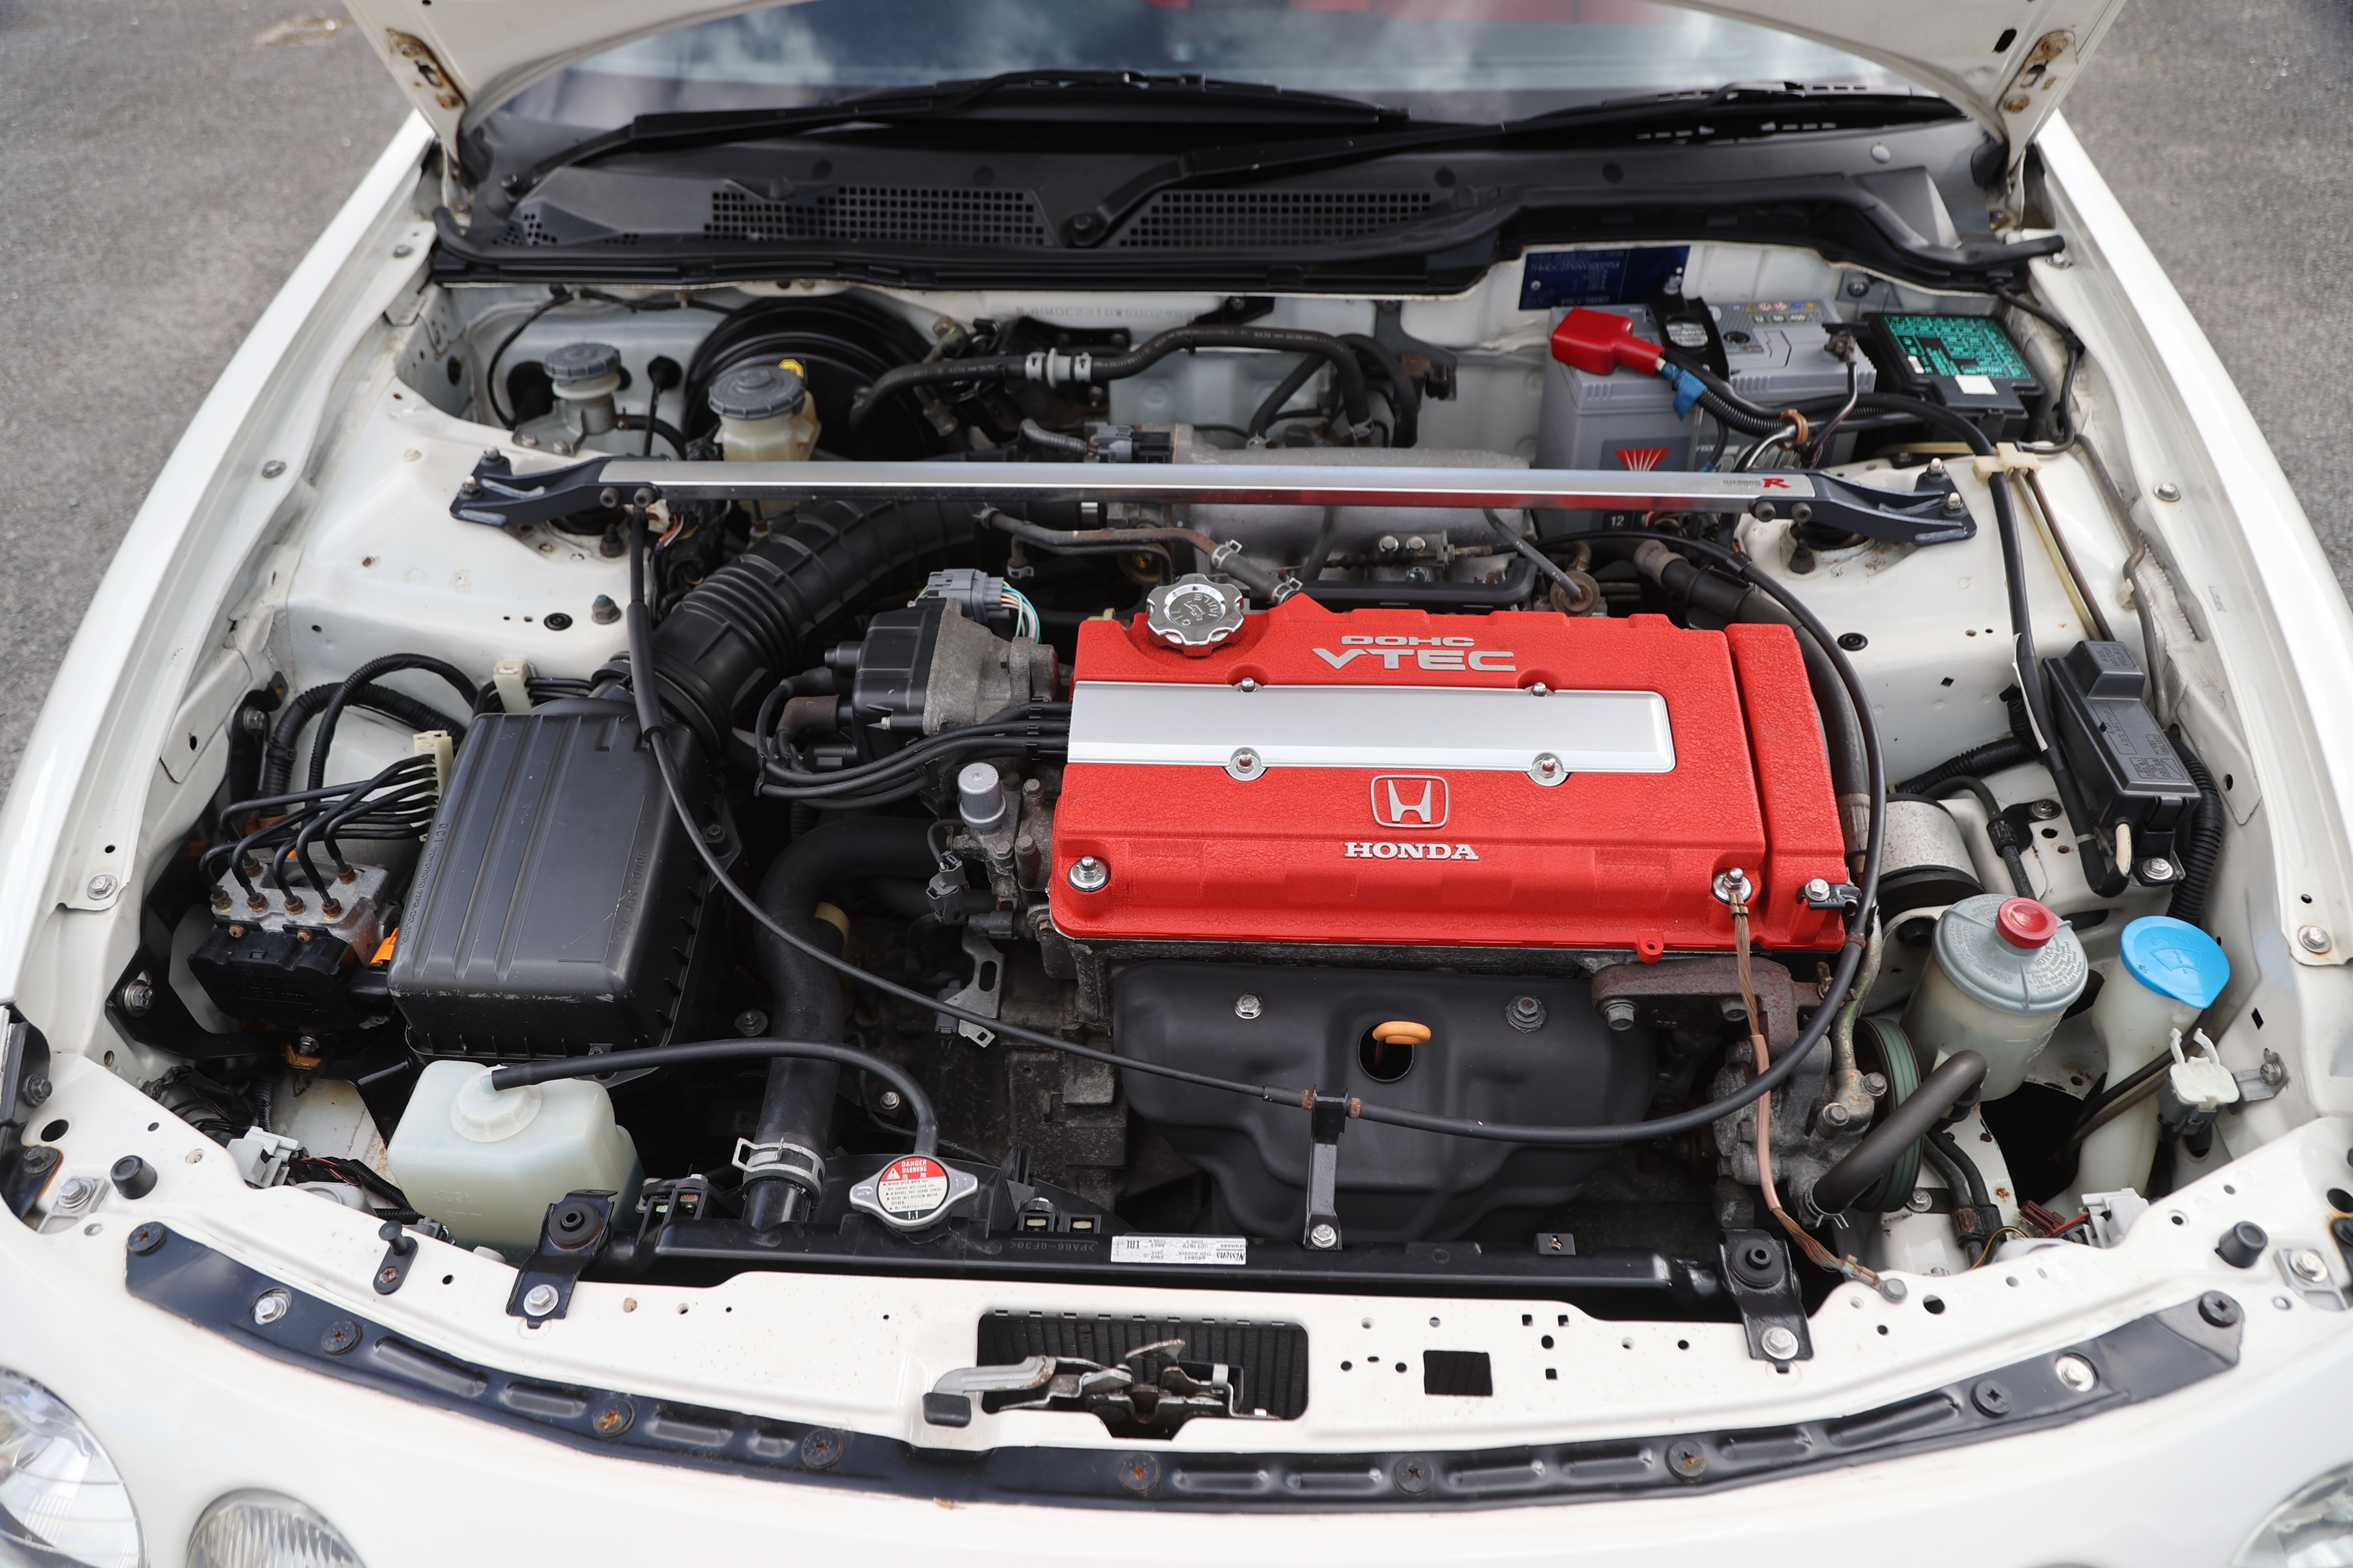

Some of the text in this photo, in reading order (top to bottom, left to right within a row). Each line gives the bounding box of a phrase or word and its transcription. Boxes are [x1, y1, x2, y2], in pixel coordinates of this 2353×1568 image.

[1611, 515, 1625, 527] 12
[1171, 608, 1191, 626] OIL
[1341, 635, 1475, 647] DOHC
[1311, 648, 1517, 672] VTEC
[2097, 649, 2109, 662] ABS
[2118, 733, 2131, 748] ABS
[1344, 842, 1479, 860] HONDA
[2033, 945, 2054, 968] NOTICE
[901, 1159, 927, 1167] DANGER
[901, 1166, 927, 1174] WARNUNG
[955, 1177, 968, 1188] 1.1
[908, 1210, 918, 1220] 1.1
[1216, 1251, 1245, 1262] Nissens
